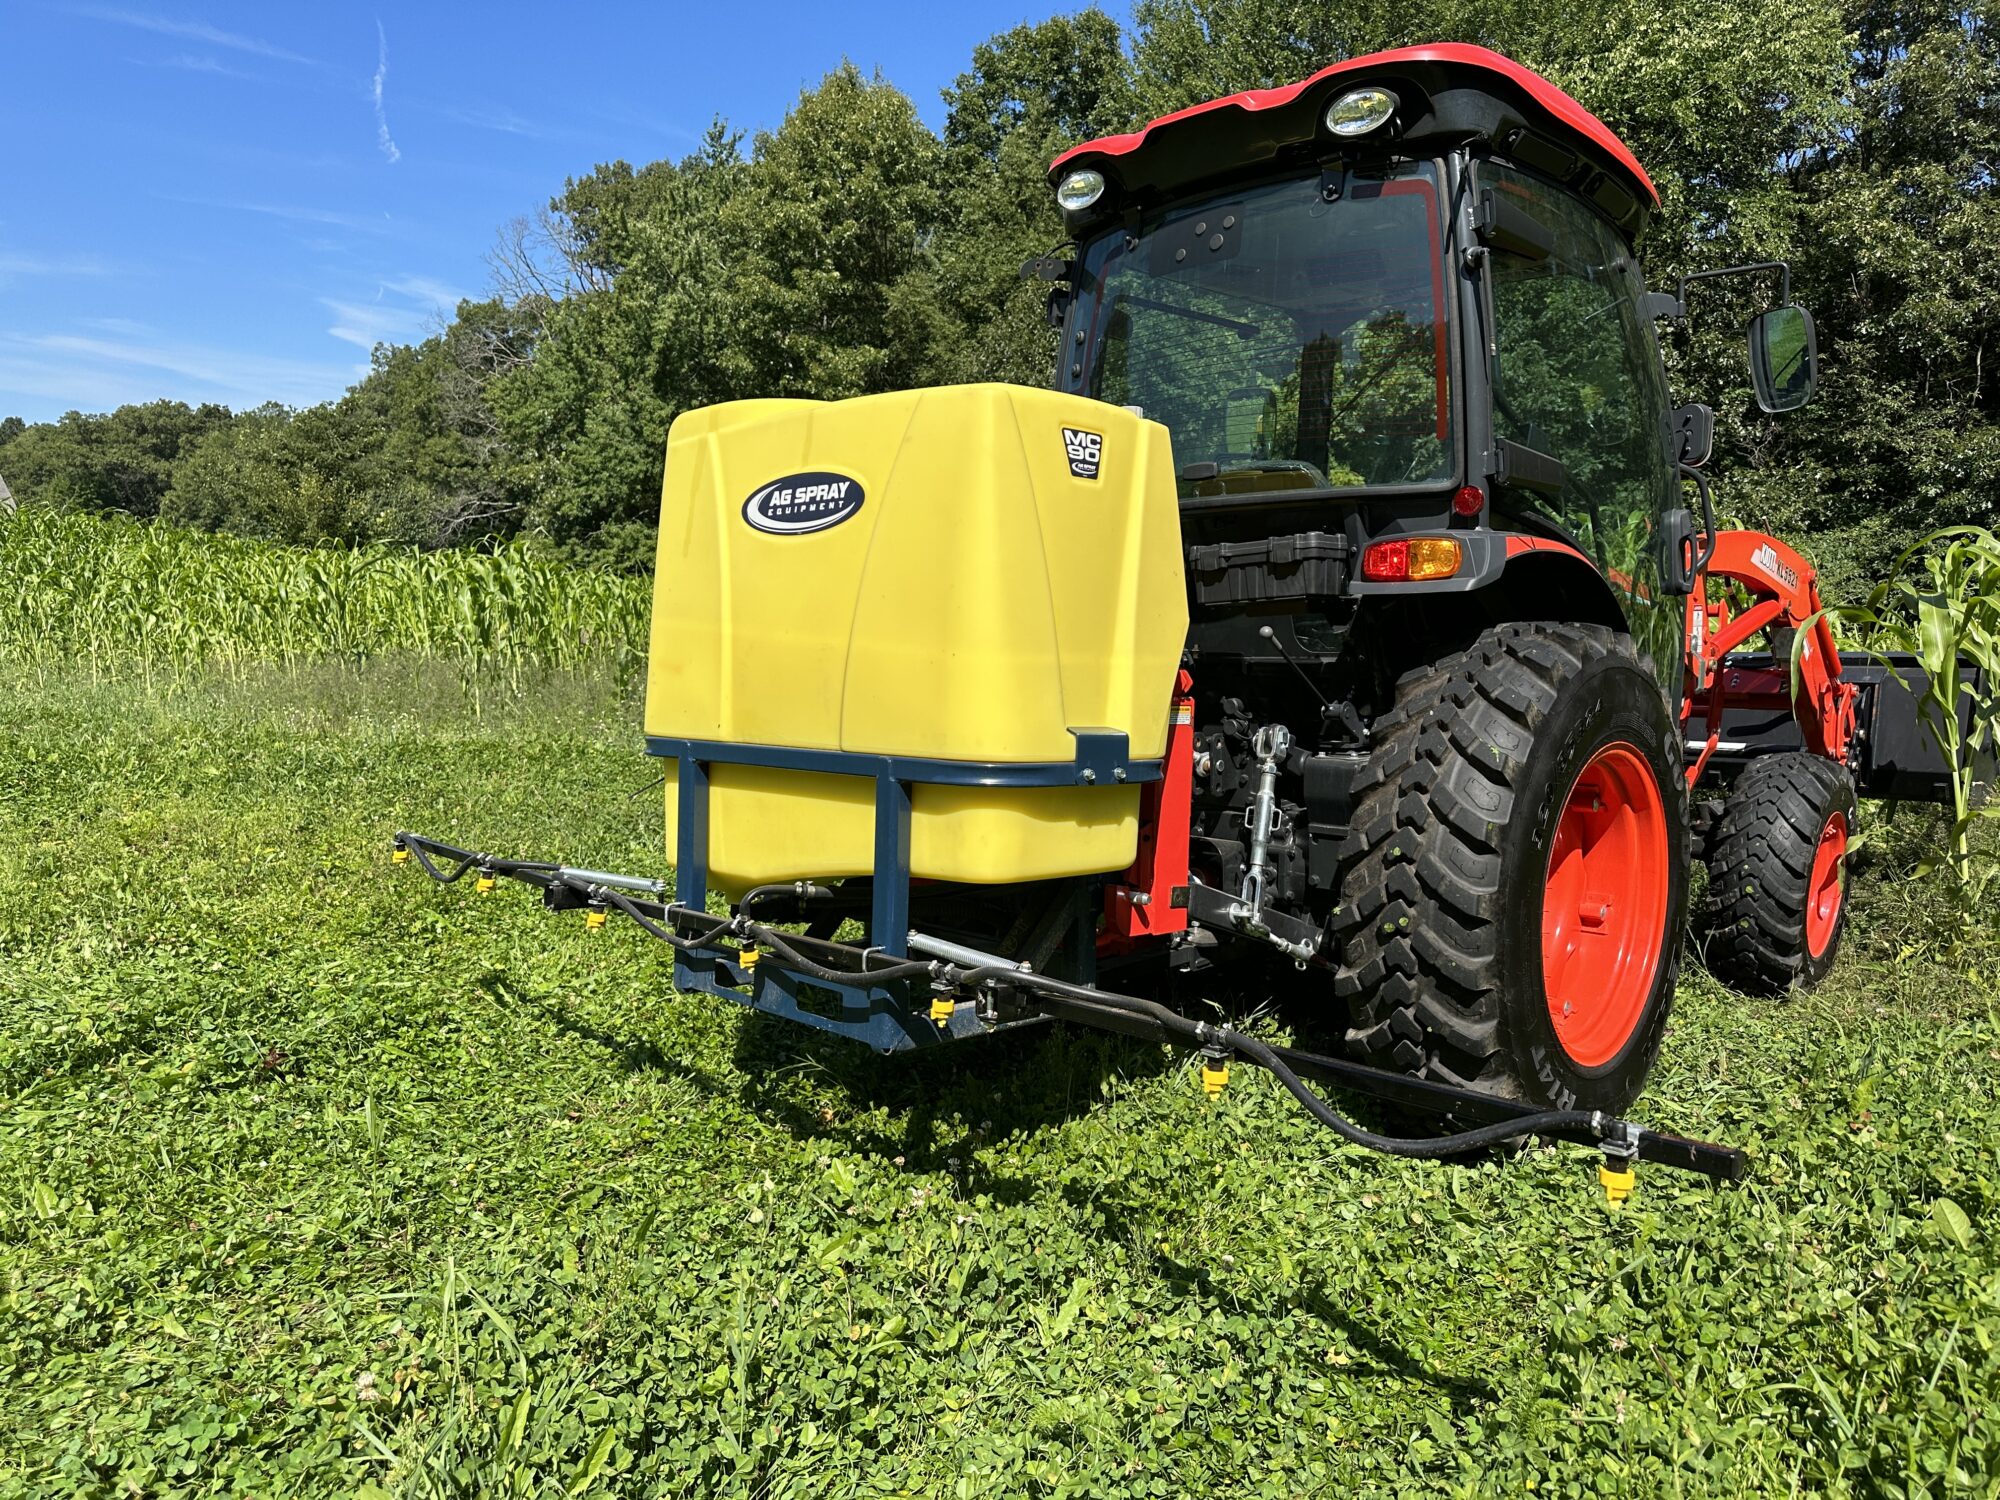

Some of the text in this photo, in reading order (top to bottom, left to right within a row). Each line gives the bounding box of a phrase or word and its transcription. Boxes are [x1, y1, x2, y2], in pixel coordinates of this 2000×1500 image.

[1063, 429, 1101, 449] MC
[1067, 444, 1100, 463] 90
[769, 481, 851, 507] AG SPRAY
[767, 501, 844, 516] EQUIPMENT
[1529, 1045, 1577, 1112] R14T
